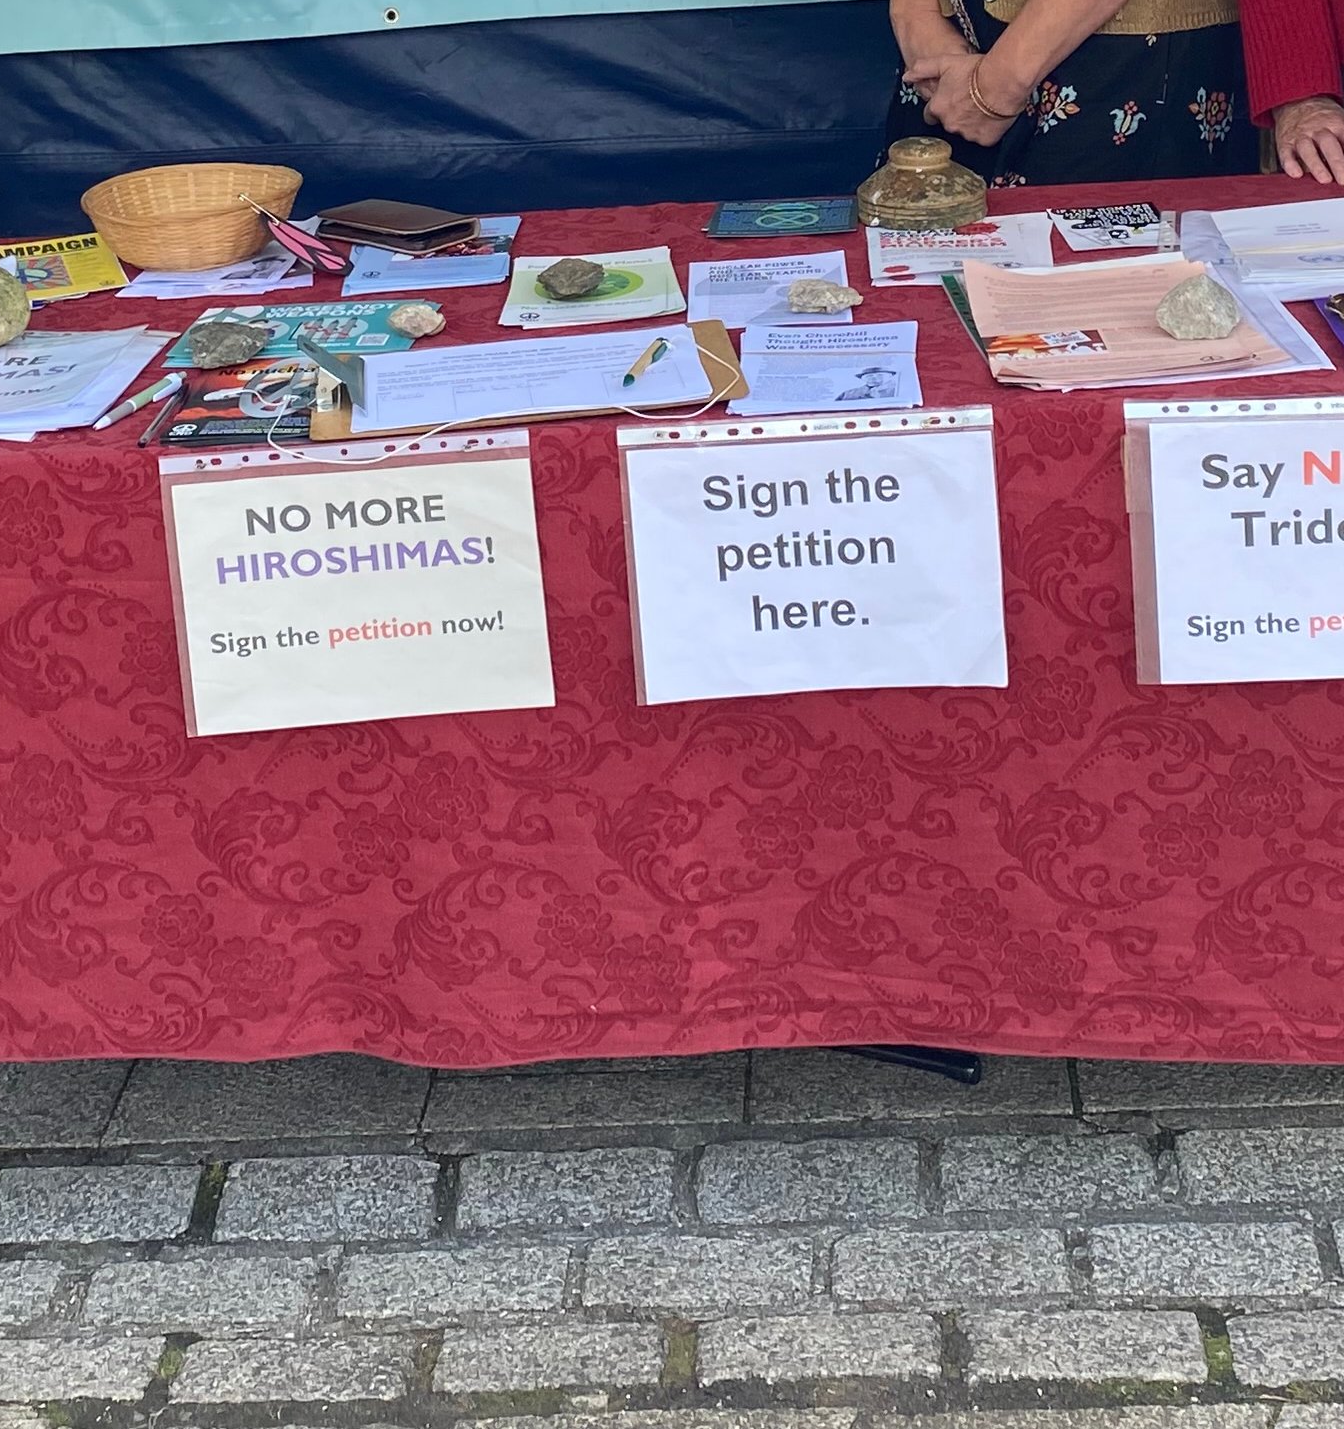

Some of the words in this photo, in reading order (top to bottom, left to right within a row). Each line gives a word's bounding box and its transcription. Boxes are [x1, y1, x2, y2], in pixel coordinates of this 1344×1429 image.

[702, 474, 809, 519] Sign
[824, 467, 900, 504] the
[1201, 453, 1286, 499] Say
[245, 504, 312, 537] NO
[324, 494, 446, 530] MORE
[216, 536, 496, 585] HIROSHIMAS!
[716, 529, 896, 582] petition
[210, 631, 267, 658] Sign
[275, 626, 320, 648] the
[328, 616, 432, 650] petition
[441, 610, 504, 635] now!
[752, 594, 870, 632] here.
[1187, 614, 1245, 643] Sign
[1254, 612, 1300, 635] the
